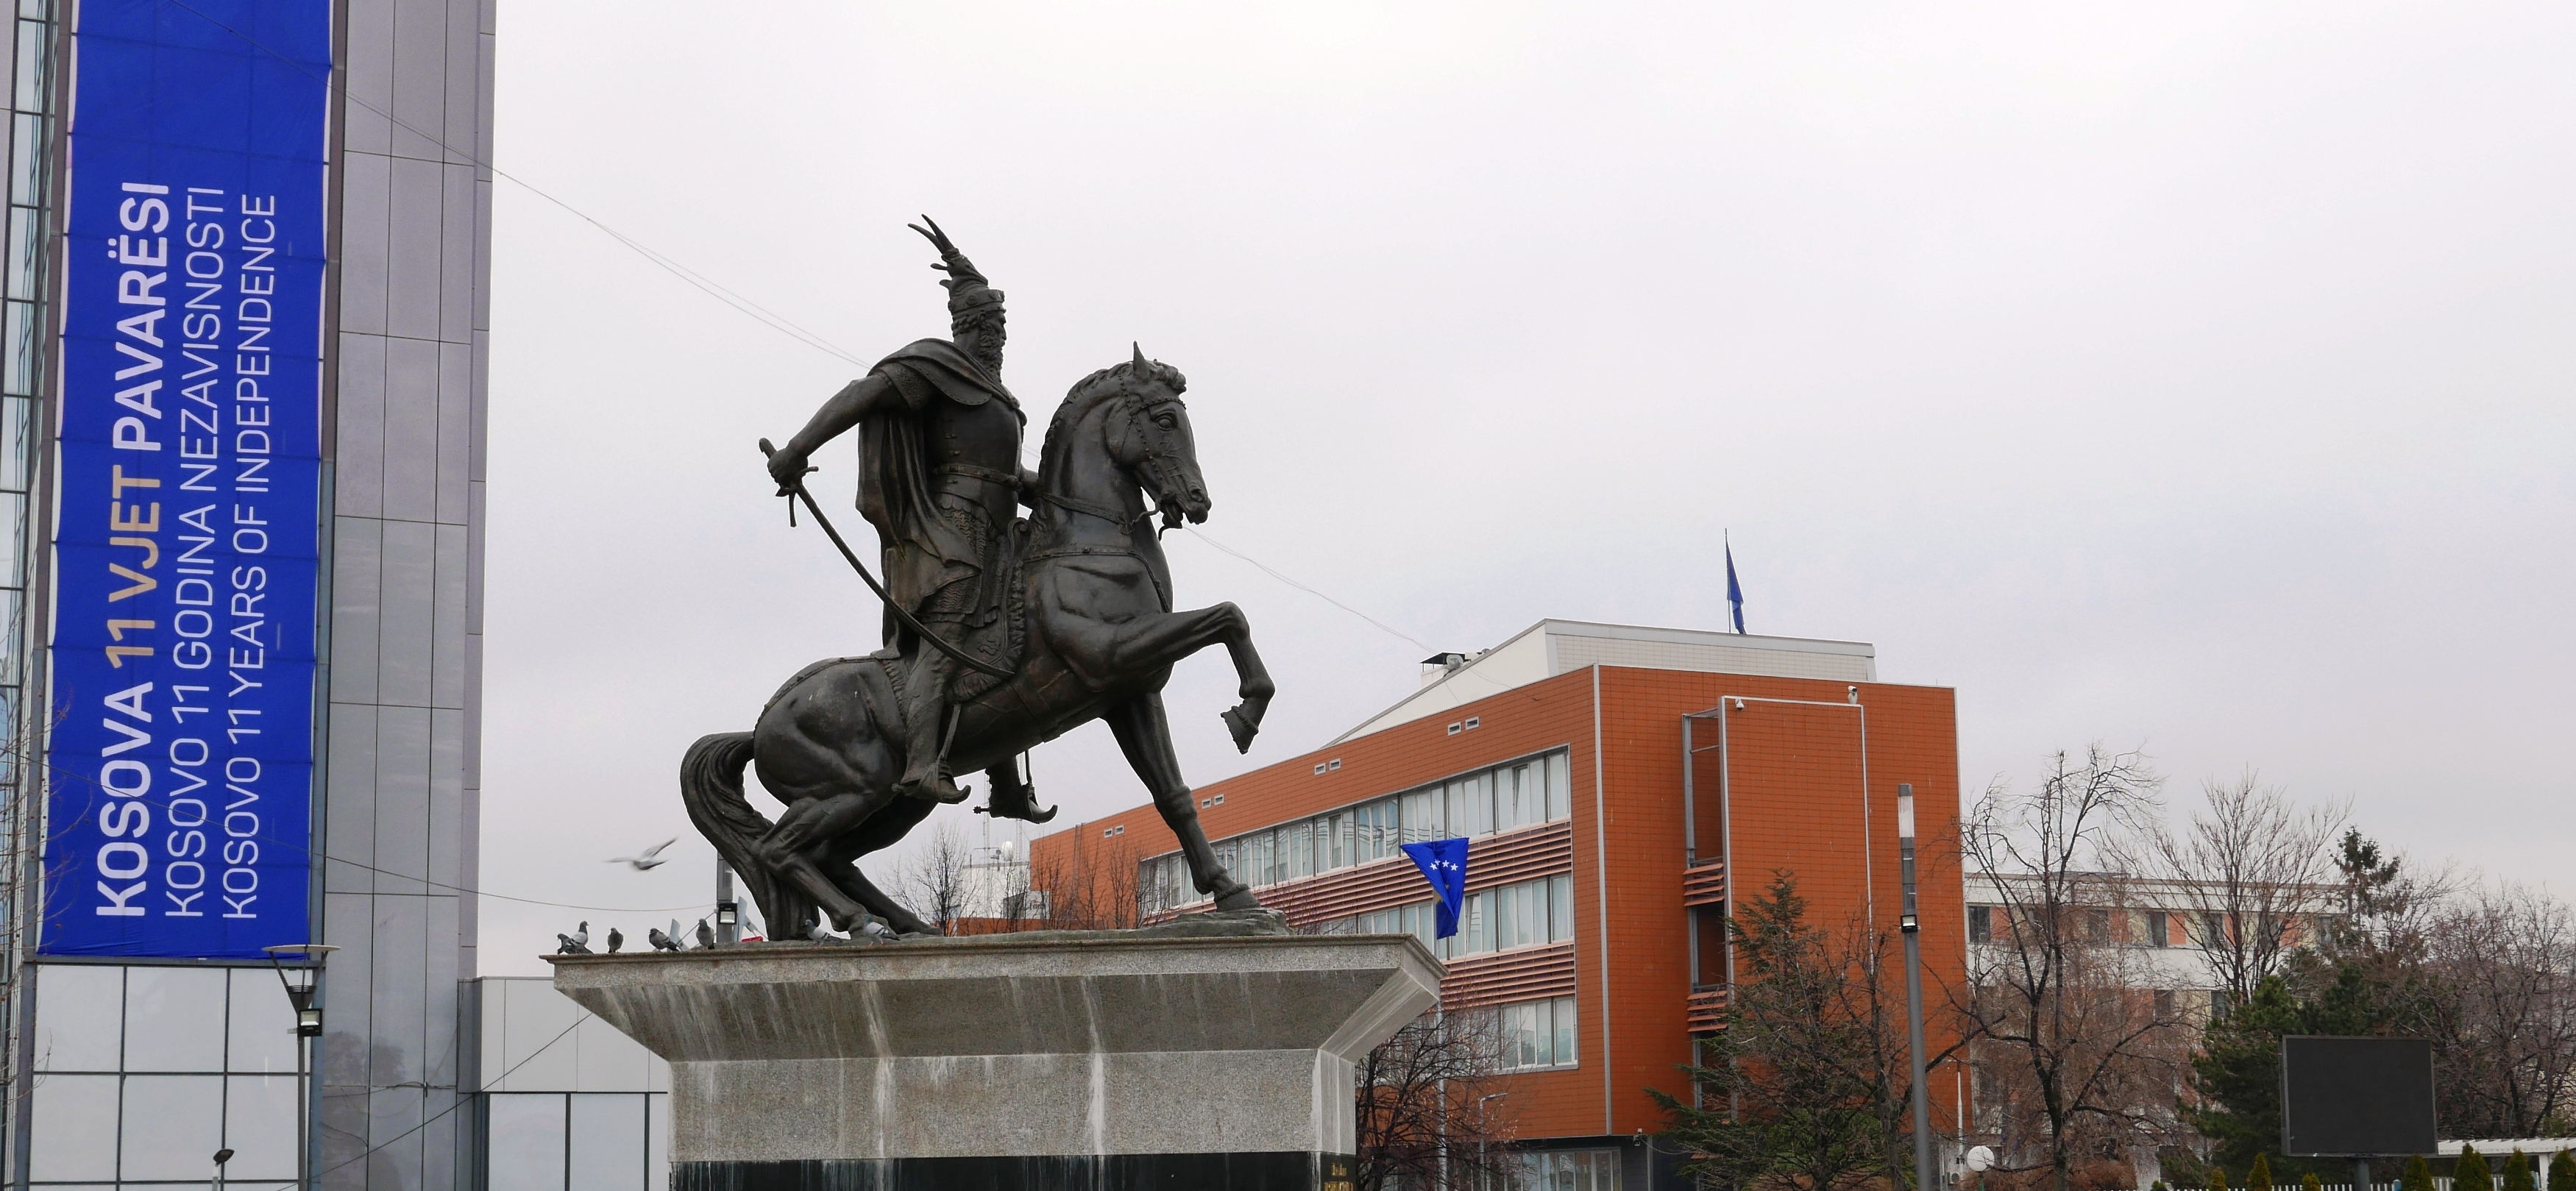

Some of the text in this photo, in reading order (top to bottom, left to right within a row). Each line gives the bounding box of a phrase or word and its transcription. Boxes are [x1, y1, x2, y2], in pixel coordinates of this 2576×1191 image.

[96, 182, 169, 916] KOSOVA 11 VJET PAVARËSI
[166, 188, 224, 917] KOSOVO 11 GODINA NEZAVISNOSTI
[223, 195, 275, 918] KOSOVO 11 YEARS OF INDEPENDENCE
